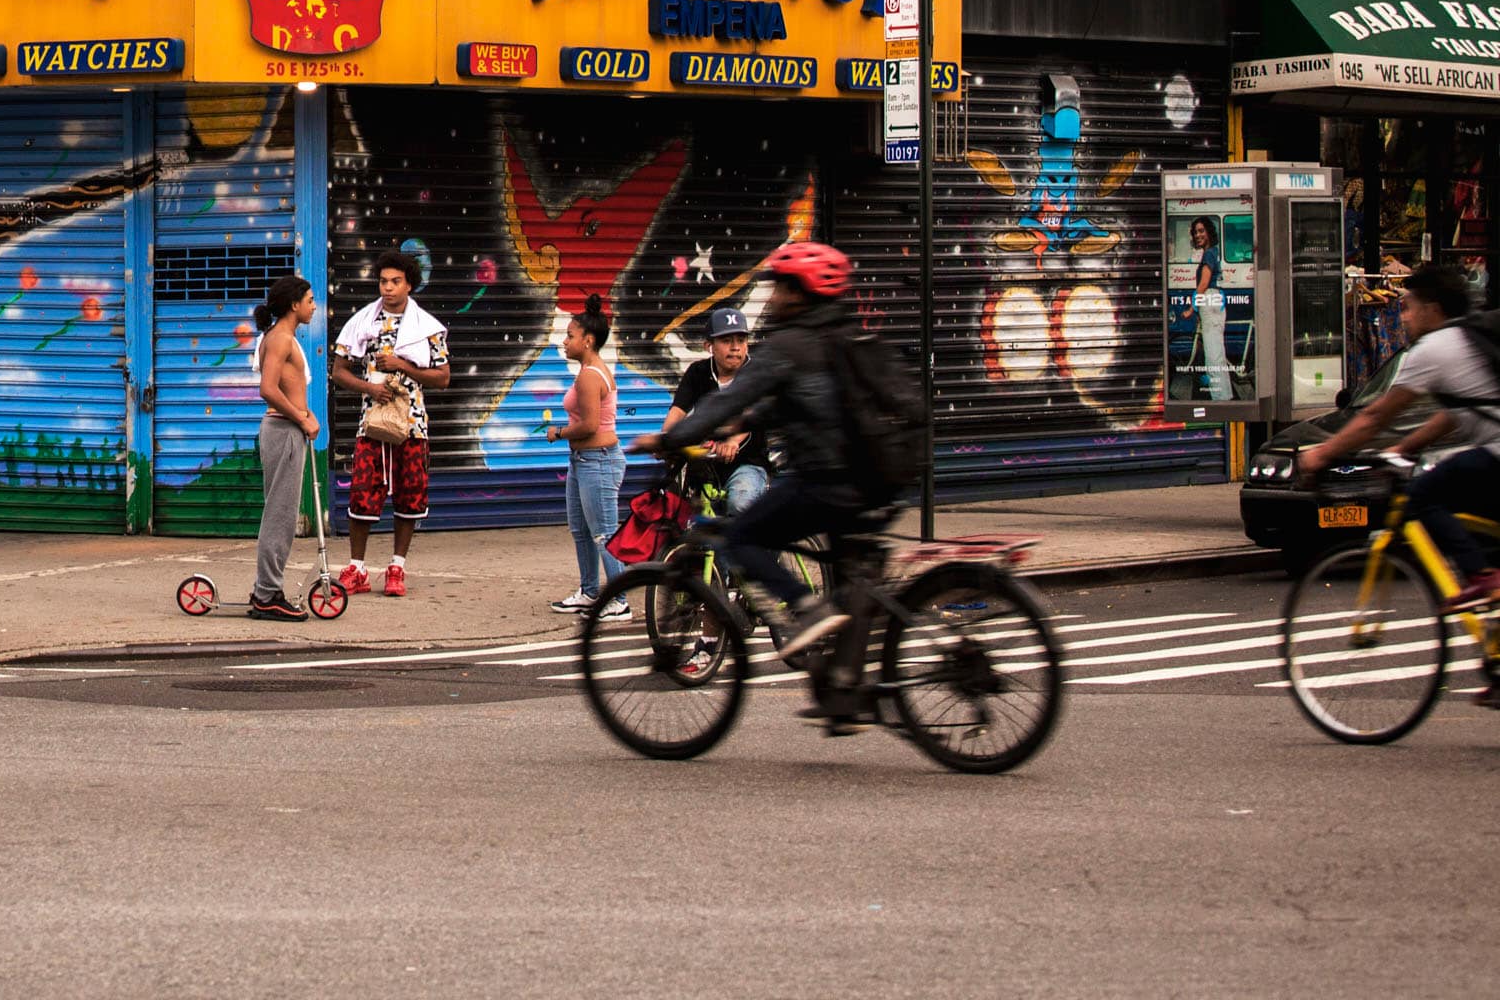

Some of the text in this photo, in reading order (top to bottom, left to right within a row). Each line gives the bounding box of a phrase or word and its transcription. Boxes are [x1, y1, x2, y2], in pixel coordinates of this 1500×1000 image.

[1329, 1, 1436, 41] BABA
[24, 42, 169, 72] WATCHES
[476, 44, 529, 61] WE BUY
[266, 61, 364, 77] 50 E 125th St.
[477, 60, 528, 75] & SELL
[576, 49, 645, 79] GOLD
[686, 54, 813, 85] DIAMONDS
[1233, 58, 1331, 79] BABA FASHION
[1233, 79, 1257, 90] TEL:
[1340, 62, 1364, 81] 1945
[1404, 66, 1432, 86] SELL
[1436, 68, 1494, 91] AFRICAN
[887, 146, 919, 160] 110197
[1188, 174, 1231, 189] TITAN
[1289, 173, 1314, 188] TITAN
[1171, 293, 1250, 307] IT'S A 212 THING
